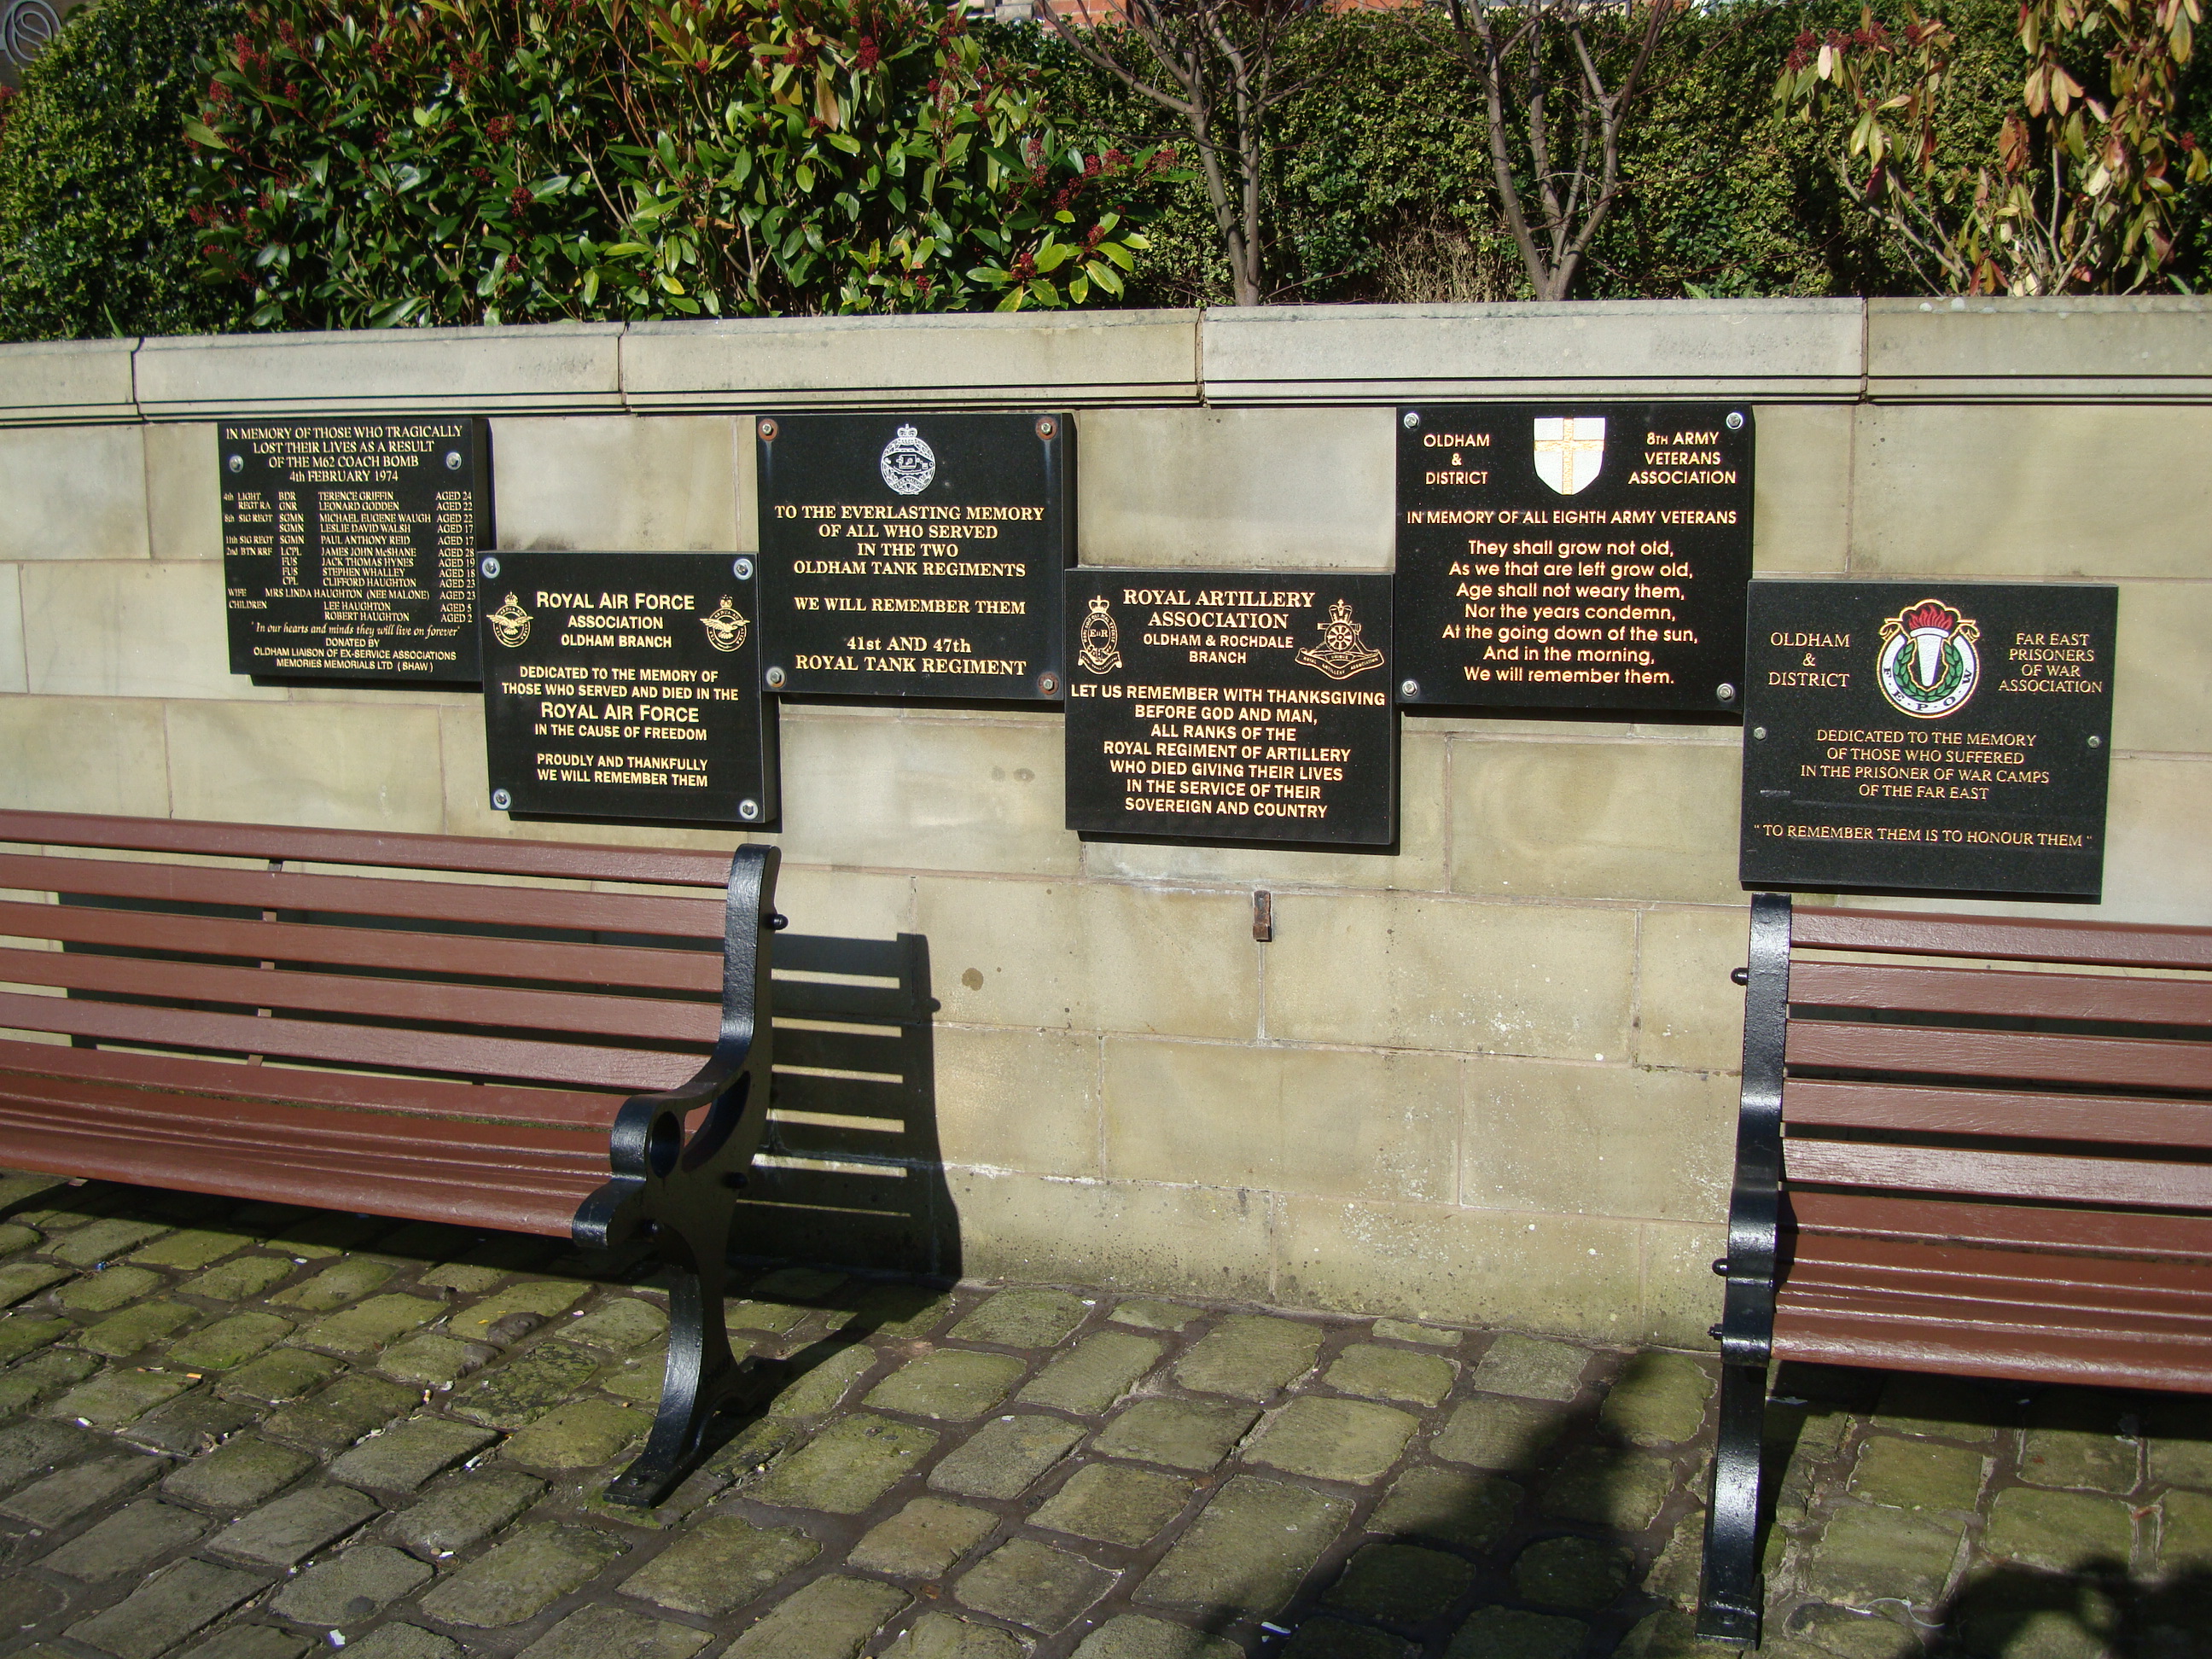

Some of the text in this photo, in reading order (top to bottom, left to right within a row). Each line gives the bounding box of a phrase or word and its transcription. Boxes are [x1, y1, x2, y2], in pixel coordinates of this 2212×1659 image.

[226, 424, 463, 439] IN MEMORY OF THOSE WHO TRAGICALLY
[1672, 431, 1720, 445] ARMY
[253, 439, 434, 454] LOST THEIR LIVES AS A RESULT
[1423, 433, 1490, 447] OLDHAM
[268, 455, 419, 469] OF THE M62 COACH BOMB
[1451, 452, 1463, 466] &
[1644, 451, 1721, 465] VETERANS
[307, 469, 370, 482] FEBRUARY
[375, 469, 399, 481] 1974
[1425, 470, 1488, 485] DISTRICT
[1627, 470, 1736, 485] ASSOCIATION
[237, 492, 261, 501] LIGHT
[278, 491, 296, 501] BDR
[317, 491, 393, 501] TERENCE GRIFFIN
[435, 491, 472, 501] AGED 24
[318, 501, 399, 511] LEONARD GODDEN
[774, 504, 1045, 521] TO THE EVERLASTING MEMORY
[279, 513, 304, 522] SGMN
[319, 513, 431, 523] MICHAEL EUGENE WAUGH
[1407, 509, 1737, 524] IN MEMORY OF ALL EIGHTH ARMY VETERANS
[240, 546, 256, 556] BTN
[1468, 539, 1674, 559] They shall grow not old,
[794, 560, 1026, 577] OLDHAM TANK REGIMENTS
[229, 600, 267, 609] CHILDREN
[536, 591, 695, 610] ROYAL AIR FORCE
[794, 597, 1026, 614] WE WILL REMEMBER THEM
[1122, 589, 1316, 608] ROYAL ARTILLERY
[1147, 610, 1289, 629] ASSOCIATION
[1464, 602, 1676, 622] Nor the years condemn,
[568, 614, 663, 629] ASSOCIATION
[325, 637, 380, 648] DONATED BY
[561, 633, 672, 648] OLDHAM BRANCH
[847, 636, 972, 653] 41st AND 47th
[1143, 632, 1294, 649] OLDHAM & ROCHDALE
[1770, 632, 1850, 648] OLDHAM
[2016, 632, 2090, 646] FAR EAST
[253, 646, 457, 661] OLDHAM LIAISON OF EX-SERVICE ASSOCIATIONS
[1189, 650, 1246, 664] BRANCH
[1802, 652, 1816, 667] &
[2008, 648, 2094, 661] PRISONERS
[795, 655, 1027, 675] ROYAL TANK REGIMENT
[2021, 663, 2081, 678] OF WAR
[520, 666, 719, 683] DEDICATED TO THE MEMORY OF
[1464, 666, 1674, 684] We will remember them.
[1767, 671, 1850, 688] DISTRICT
[1998, 678, 2102, 693] ASSOCIATION
[1071, 684, 1385, 706] LET US REMEMBER WITH THANKSGIVING
[1816, 729, 2037, 747] DEDICATED TO THE MEMORY
[1103, 741, 1351, 762] ROYAL REGIMENT OF ARTILLERY
[1826, 747, 2024, 765] OF THOSE WHO SUFFERED
[537, 753, 708, 771] PROUDLY AND THANKFULLY
[1801, 765, 2049, 783] IN THE PRISONER OF WAR CAMPS
[1125, 796, 1328, 818] SOVEREIGN AND COUNTRY
